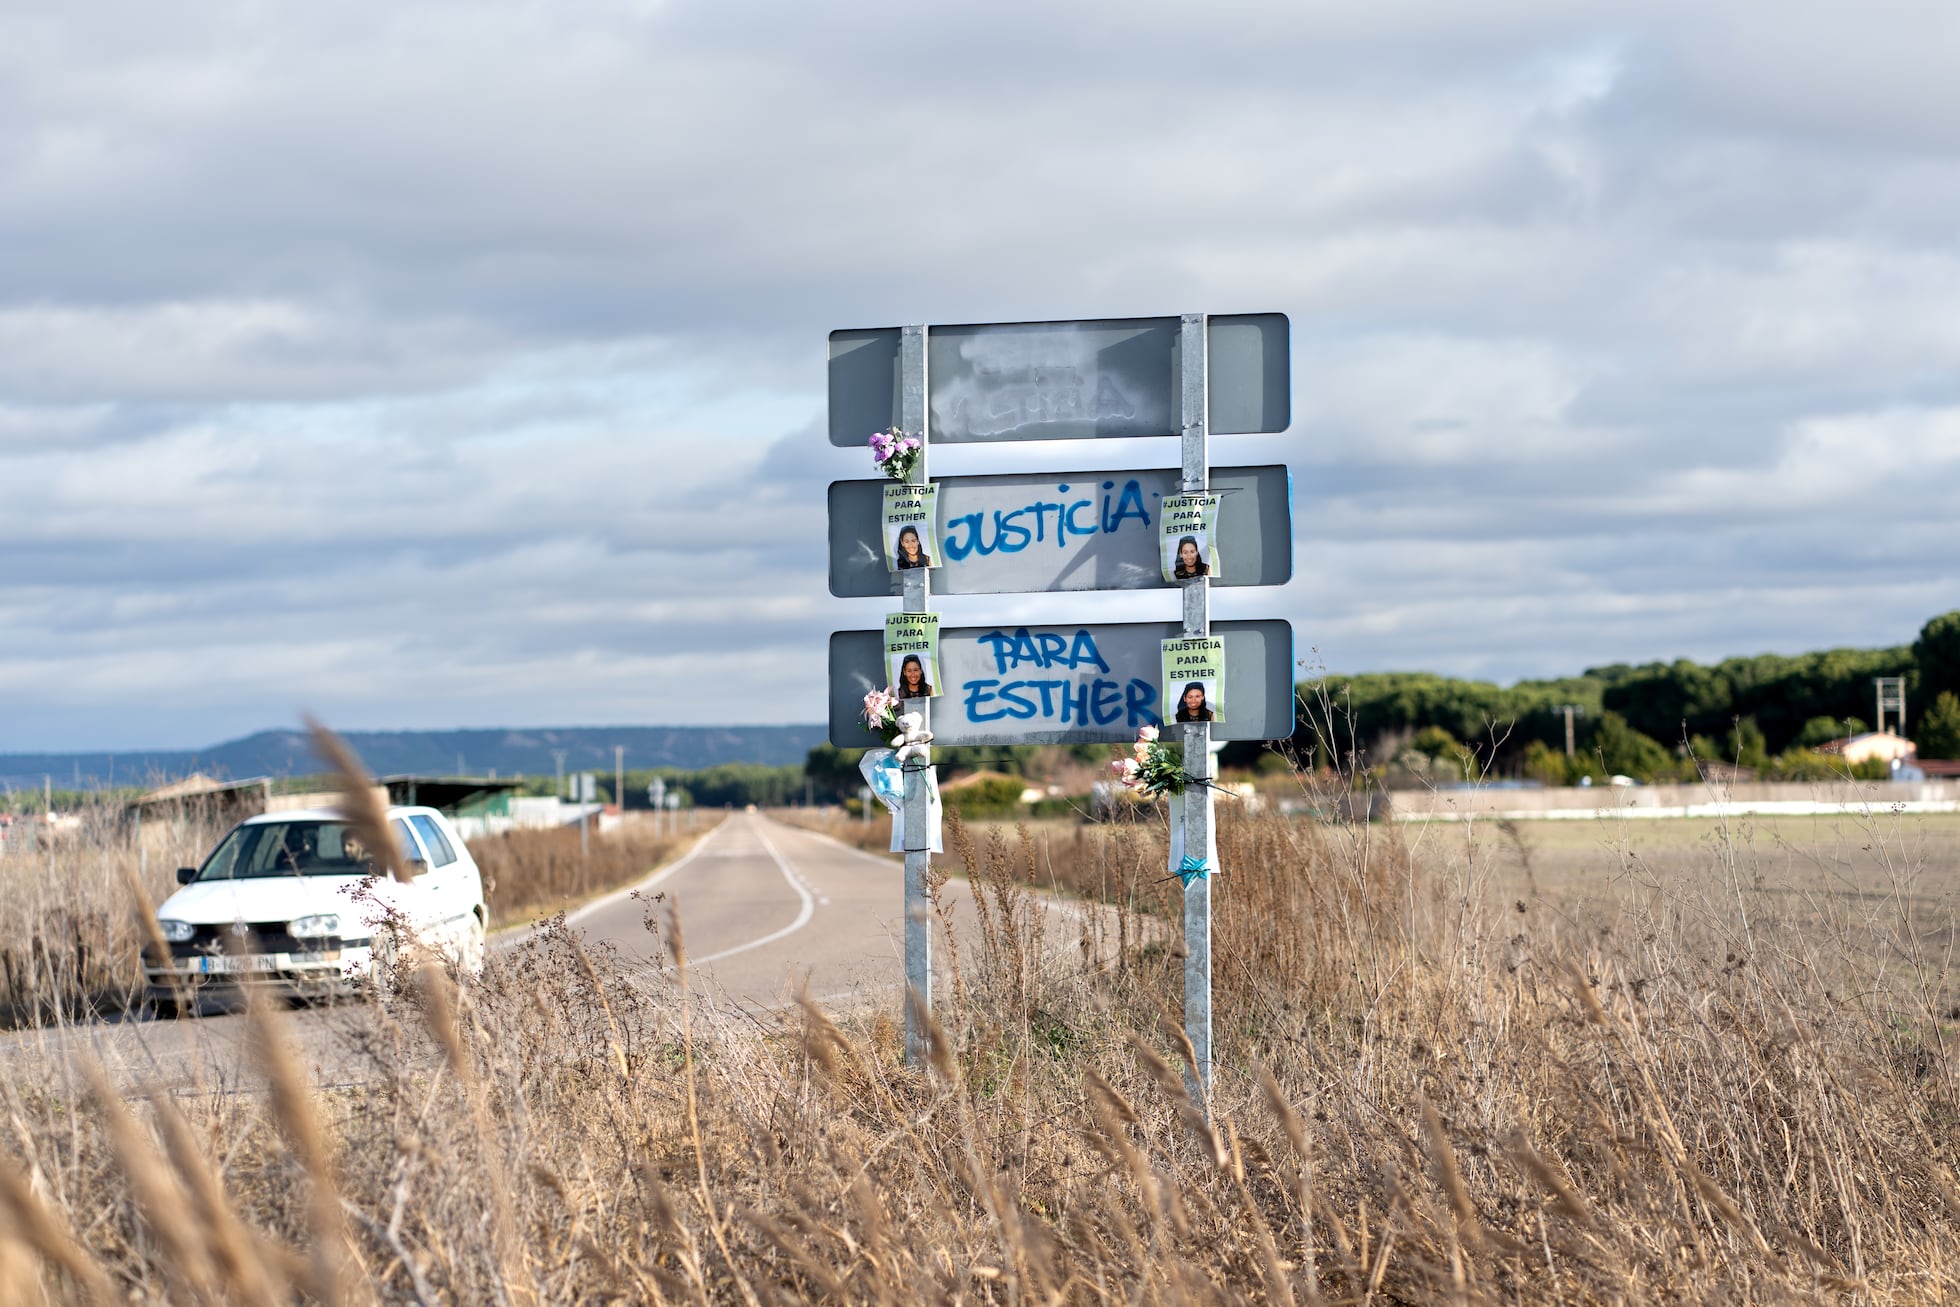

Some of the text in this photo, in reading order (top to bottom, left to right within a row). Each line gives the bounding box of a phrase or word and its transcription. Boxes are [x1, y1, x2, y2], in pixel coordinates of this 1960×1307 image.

[885, 487, 935, 497] #JUSTICIA
[894, 500, 921, 509] PARA
[1163, 498, 1216, 508] #JUSTICIA
[888, 512, 926, 523] ESTHER
[1173, 511, 1201, 520] PARA
[1166, 523, 1207, 534] ESTHER
[885, 616, 938, 625] #JUSTICIA
[896, 628, 924, 638] PARA
[890, 641, 929, 652] ESTHER
[977, 627, 1110, 675] PARA
[1162, 641, 1222, 652] #JUSTICIA
[1176, 655, 1207, 665] PARA
[1170, 668, 1215, 679] ESTHER
[962, 678, 1165, 727] ESTHER
